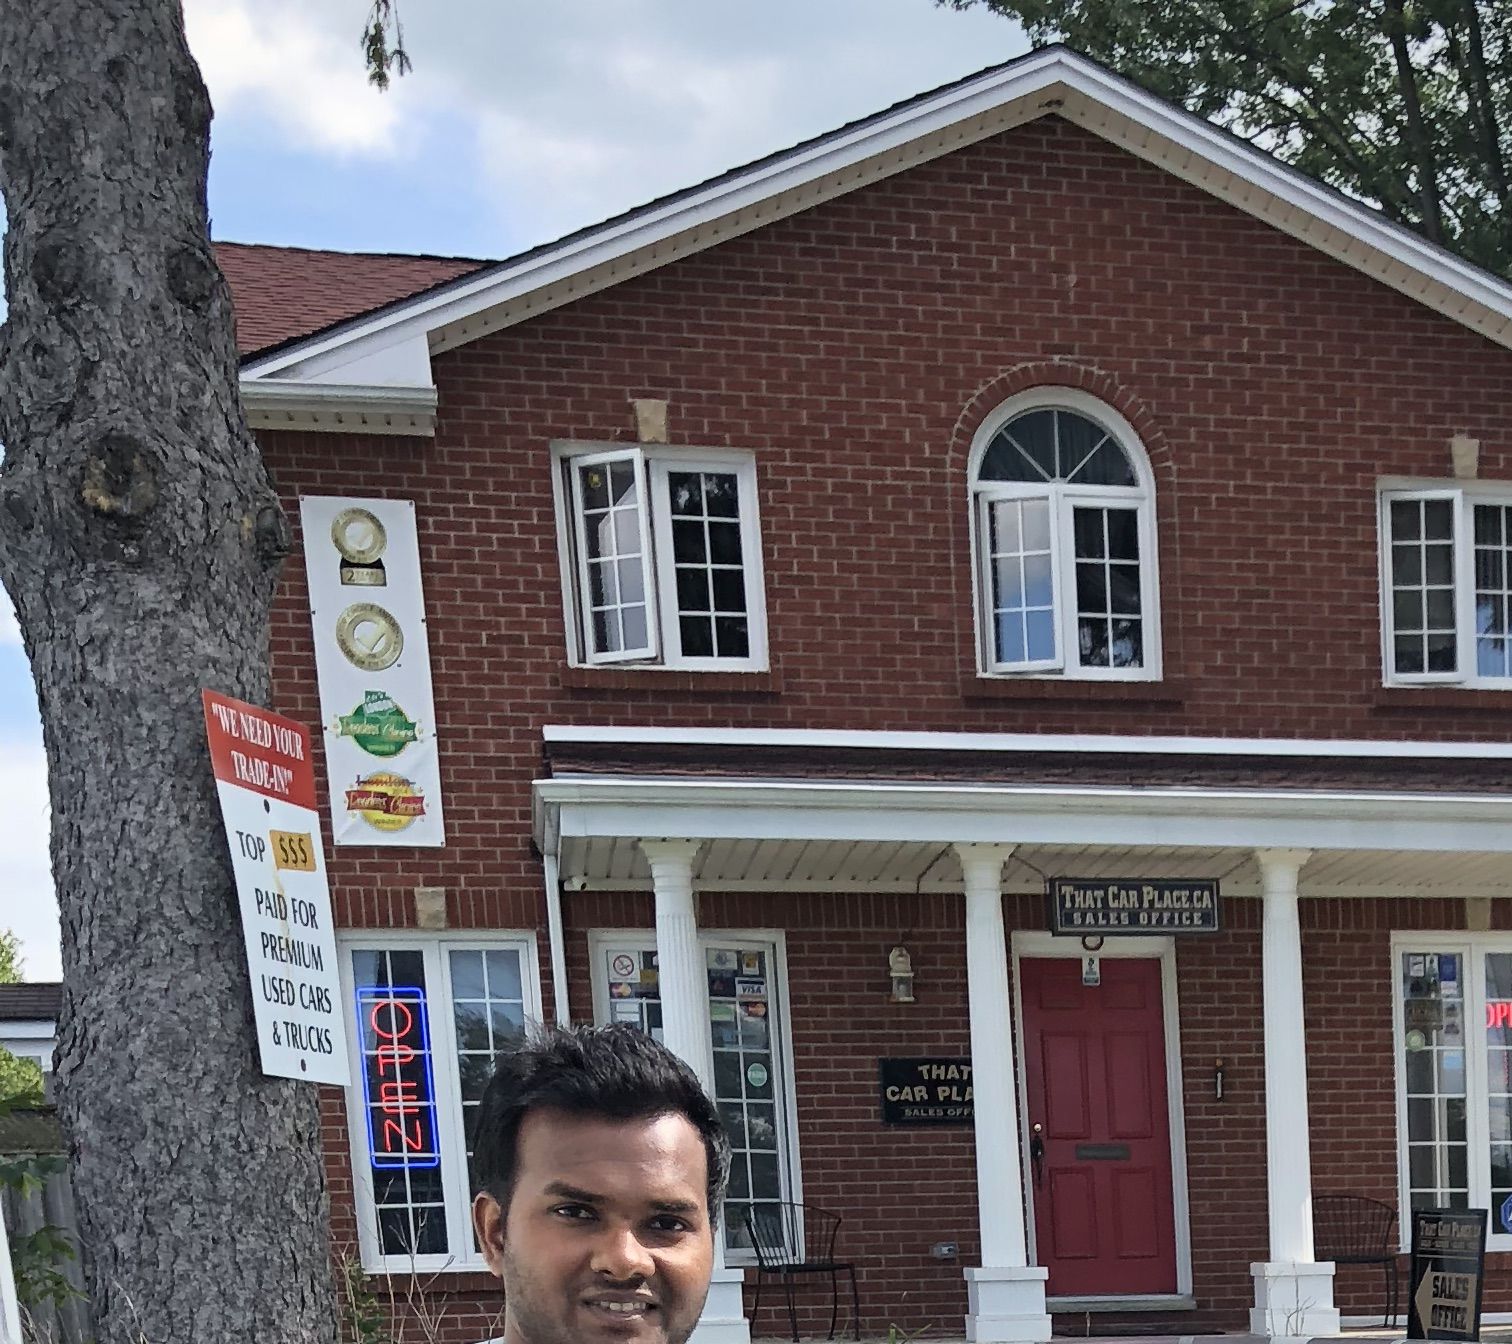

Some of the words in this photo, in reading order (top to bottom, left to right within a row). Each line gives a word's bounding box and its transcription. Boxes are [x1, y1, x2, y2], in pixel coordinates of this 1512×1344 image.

[240, 712, 272, 748] NEED
[273, 724, 304, 760] YOUR
[230, 750, 293, 795] TRADE-IN!"
[235, 830, 266, 863] TOP
[278, 835, 308, 867] $$$
[254, 888, 288, 921] PAID
[291, 898, 319, 930] FOR
[1061, 885, 1104, 909] THAT
[1108, 885, 1140, 908] CAR
[1142, 885, 1212, 909] PLACE.CA
[1073, 911, 1129, 925] SALES
[1139, 911, 1203, 925] OFFICE
[260, 931, 324, 972] PREMIUM
[261, 973, 296, 1007] USED
[299, 983, 332, 1014] CARS
[741, 985, 762, 995] VISA
[272, 1020, 282, 1046] &
[283, 1021, 333, 1055] TRUCKS
[371, 1000, 422, 1153] OPEN
[917, 1064, 972, 1080] THAT
[886, 1085, 929, 1102] CAR
[905, 1108, 944, 1117] SALES
[1431, 1275, 1469, 1301] SALES
[1431, 1303, 1468, 1330] OFFICE
